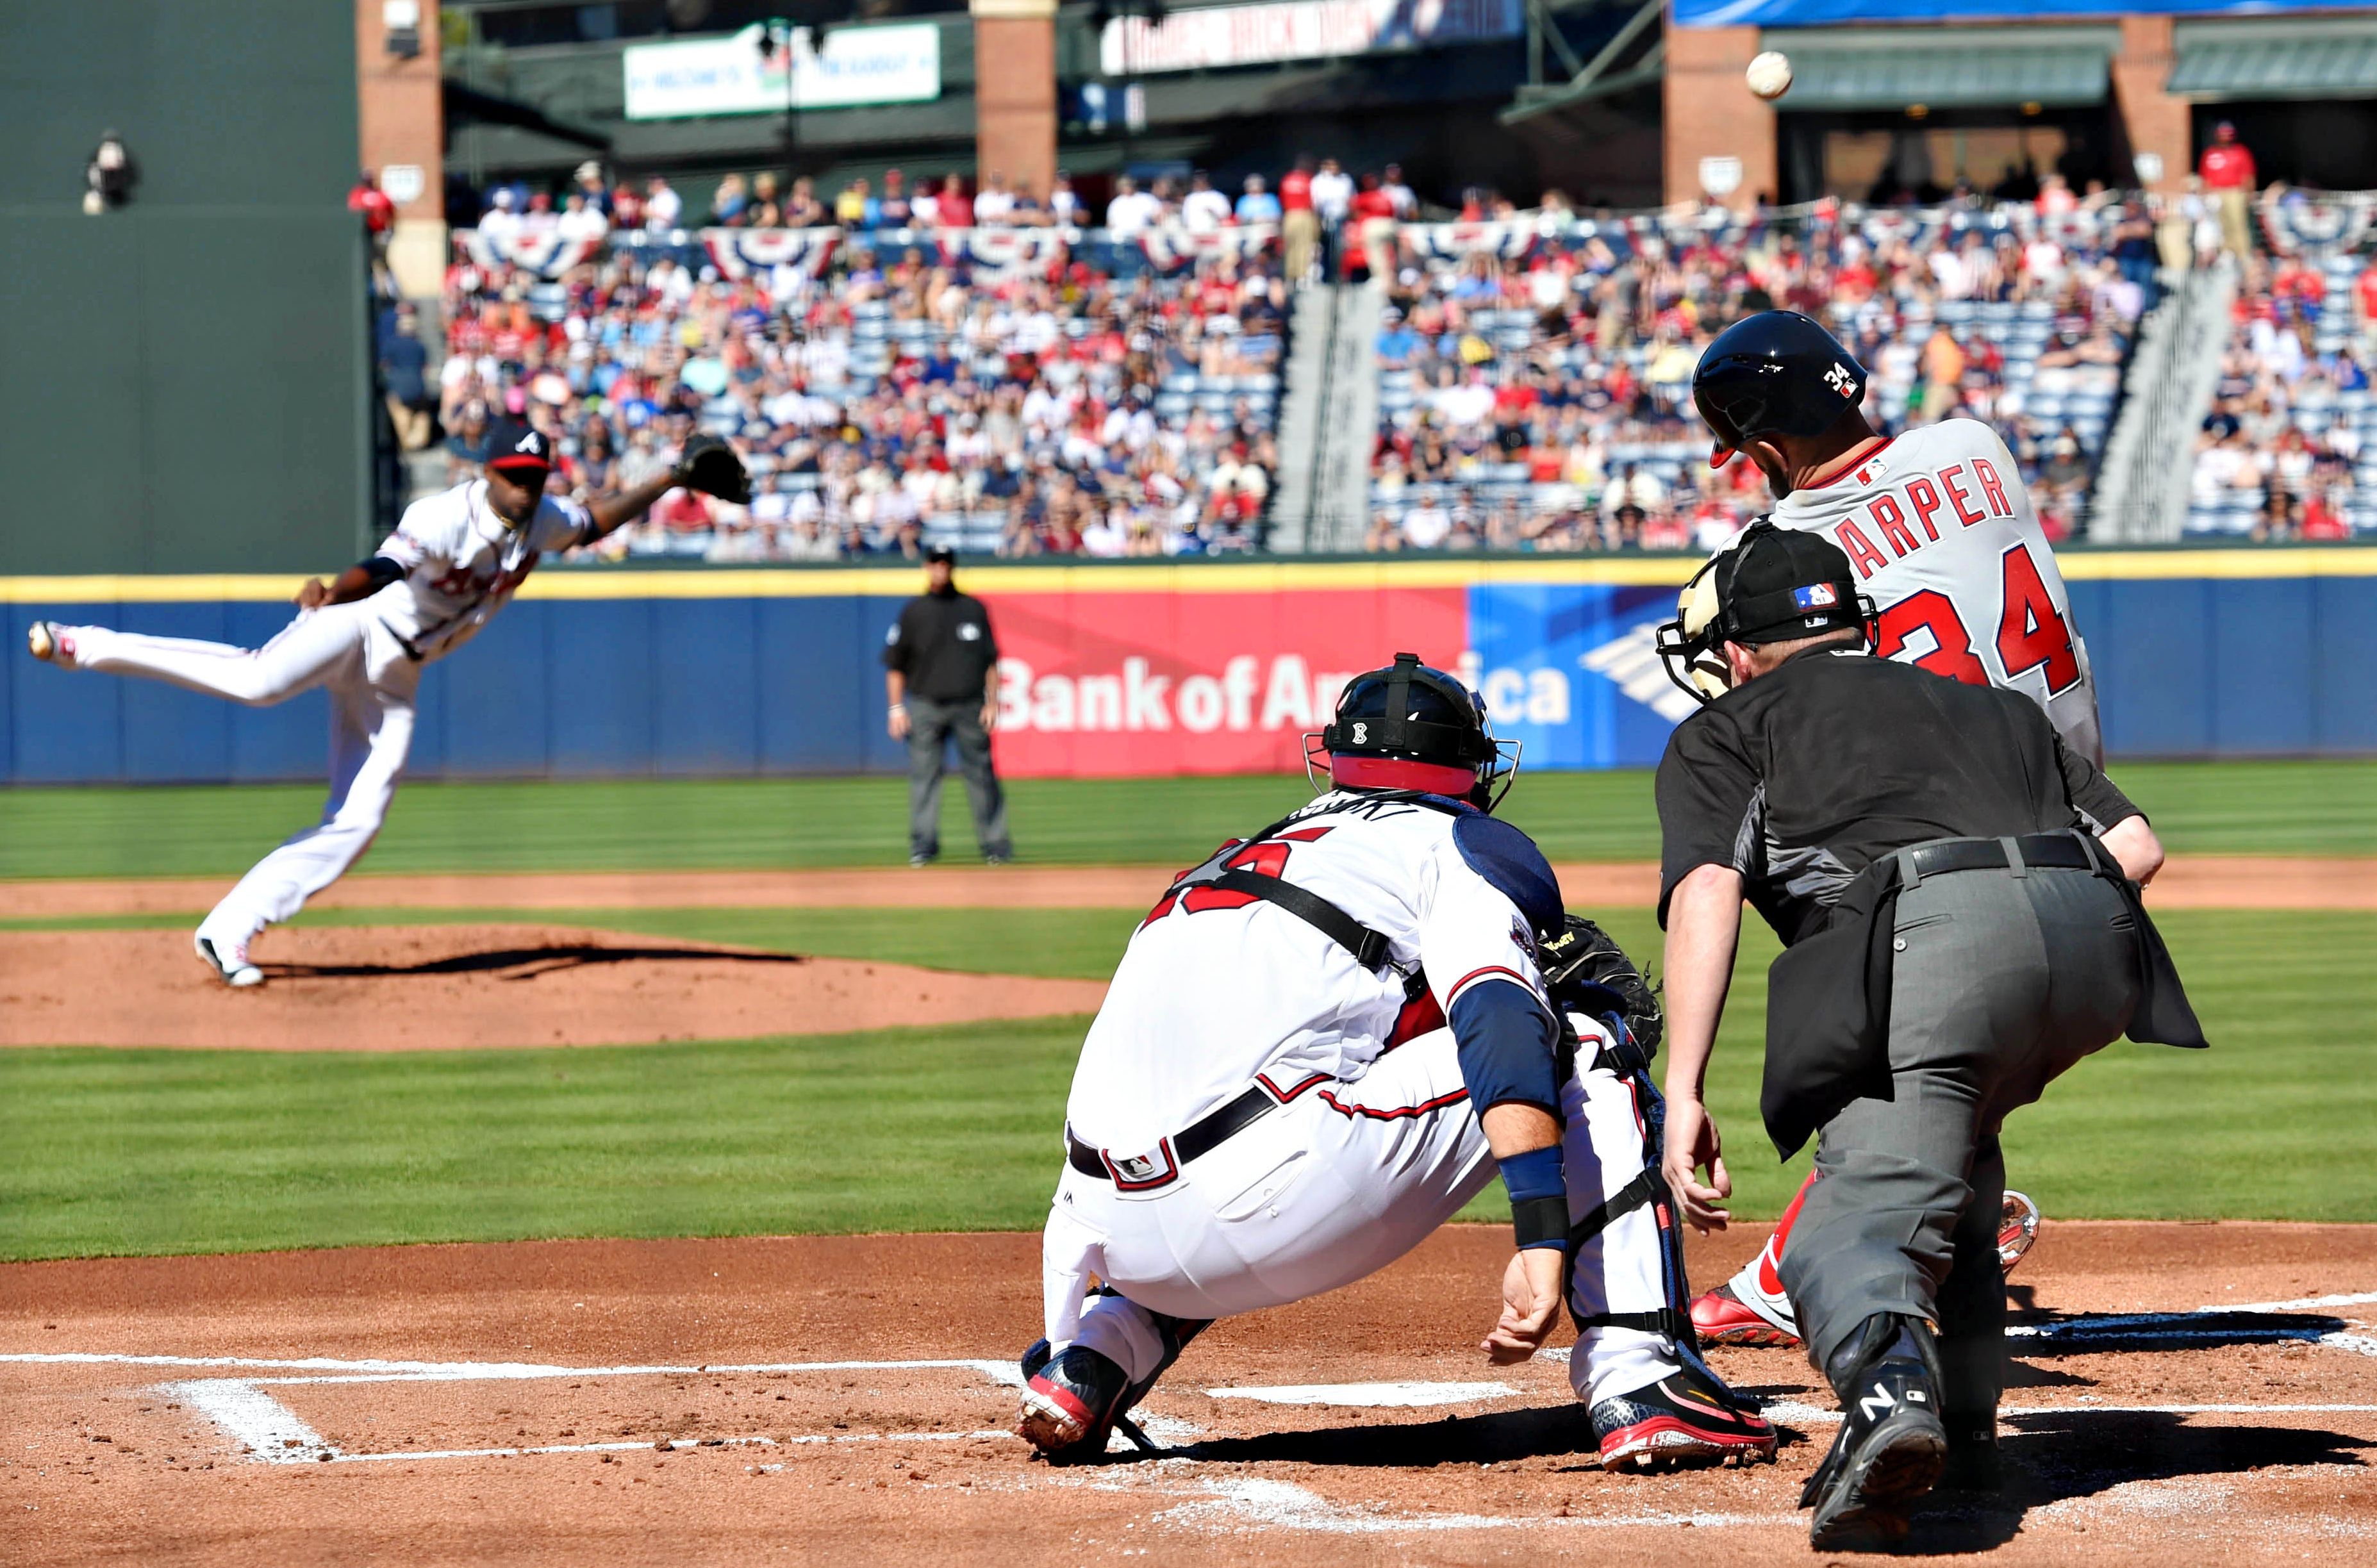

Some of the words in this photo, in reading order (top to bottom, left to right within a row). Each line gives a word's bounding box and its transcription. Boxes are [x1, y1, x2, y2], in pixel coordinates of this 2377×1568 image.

[1823, 362, 1850, 392] 34
[515, 431, 540, 454] A
[1864, 537, 2082, 700] 34
[997, 655, 1172, 732] Bank
[1175, 654, 1261, 734] of
[1261, 652, 1570, 732] Aica
